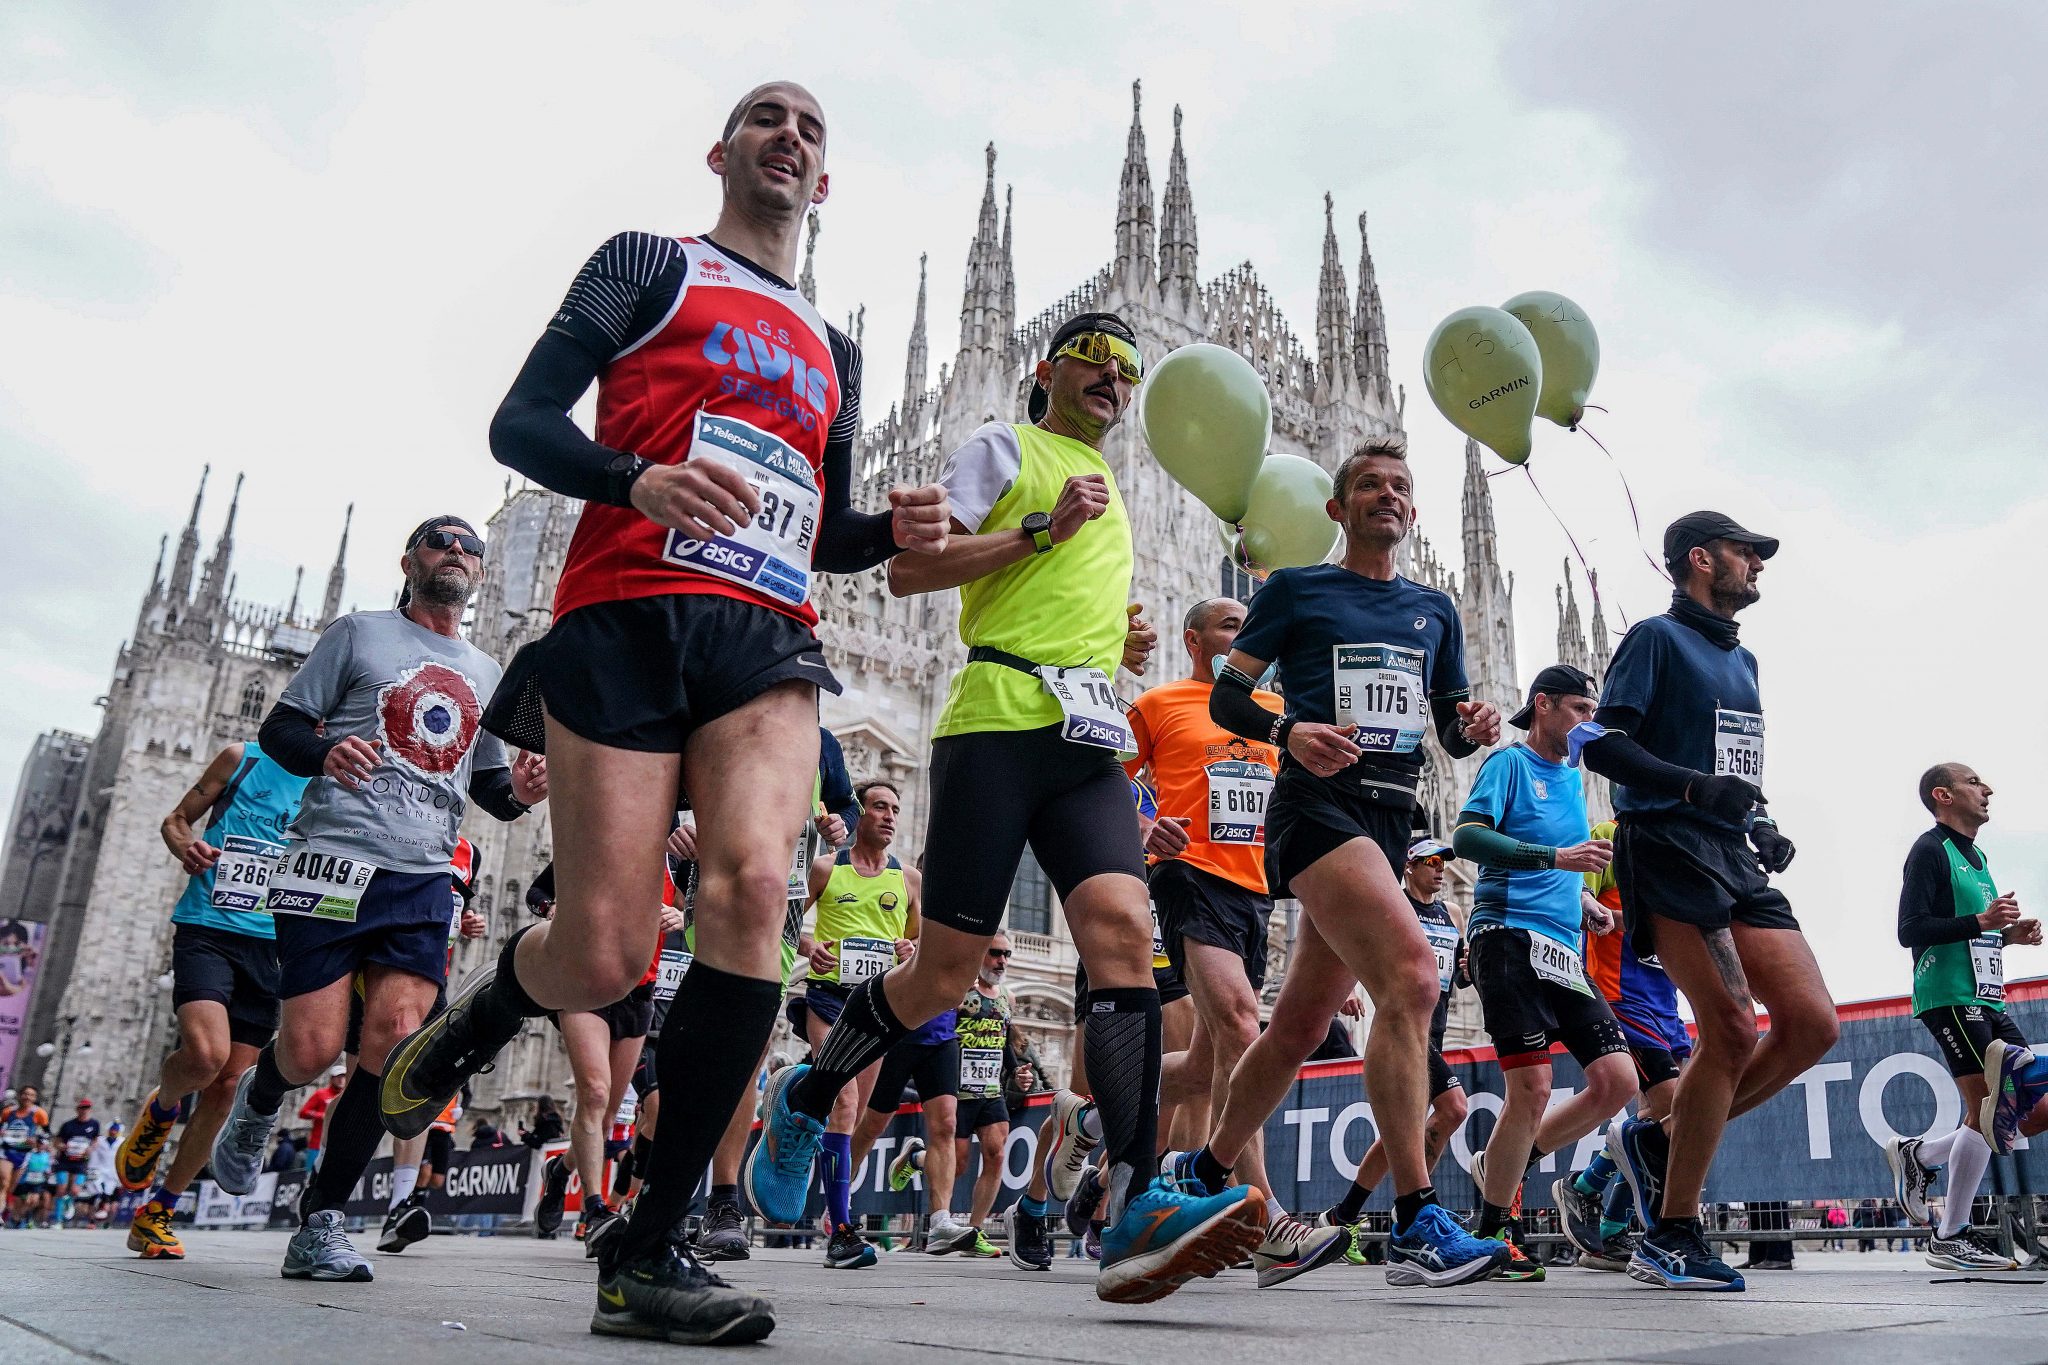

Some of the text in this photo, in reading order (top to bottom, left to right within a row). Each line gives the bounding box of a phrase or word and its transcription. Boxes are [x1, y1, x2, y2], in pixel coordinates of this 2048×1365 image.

[719, 374, 816, 432] SEREGNO
[1469, 375, 1531, 410] GARMIN
[713, 424, 759, 453] Telepass
[702, 541, 755, 572] asics
[1346, 654, 1381, 663] Telepass
[1378, 672, 1398, 682] CRISTIAN
[1364, 682, 1409, 715] 1175
[1090, 725, 1122, 744] asics
[1359, 731, 1391, 746] asics
[1726, 747, 1759, 776] 2563
[1227, 789, 1264, 814] 6187
[1226, 827, 1251, 839] asics
[292, 851, 354, 885] 4049
[226, 894, 254, 907] asics
[281, 893, 315, 909] asics
[855, 959, 884, 976] 2167
[1542, 943, 1571, 974] 2601
[971, 1066, 994, 1079] 2619
[446, 1162, 521, 1198] GARMIN
